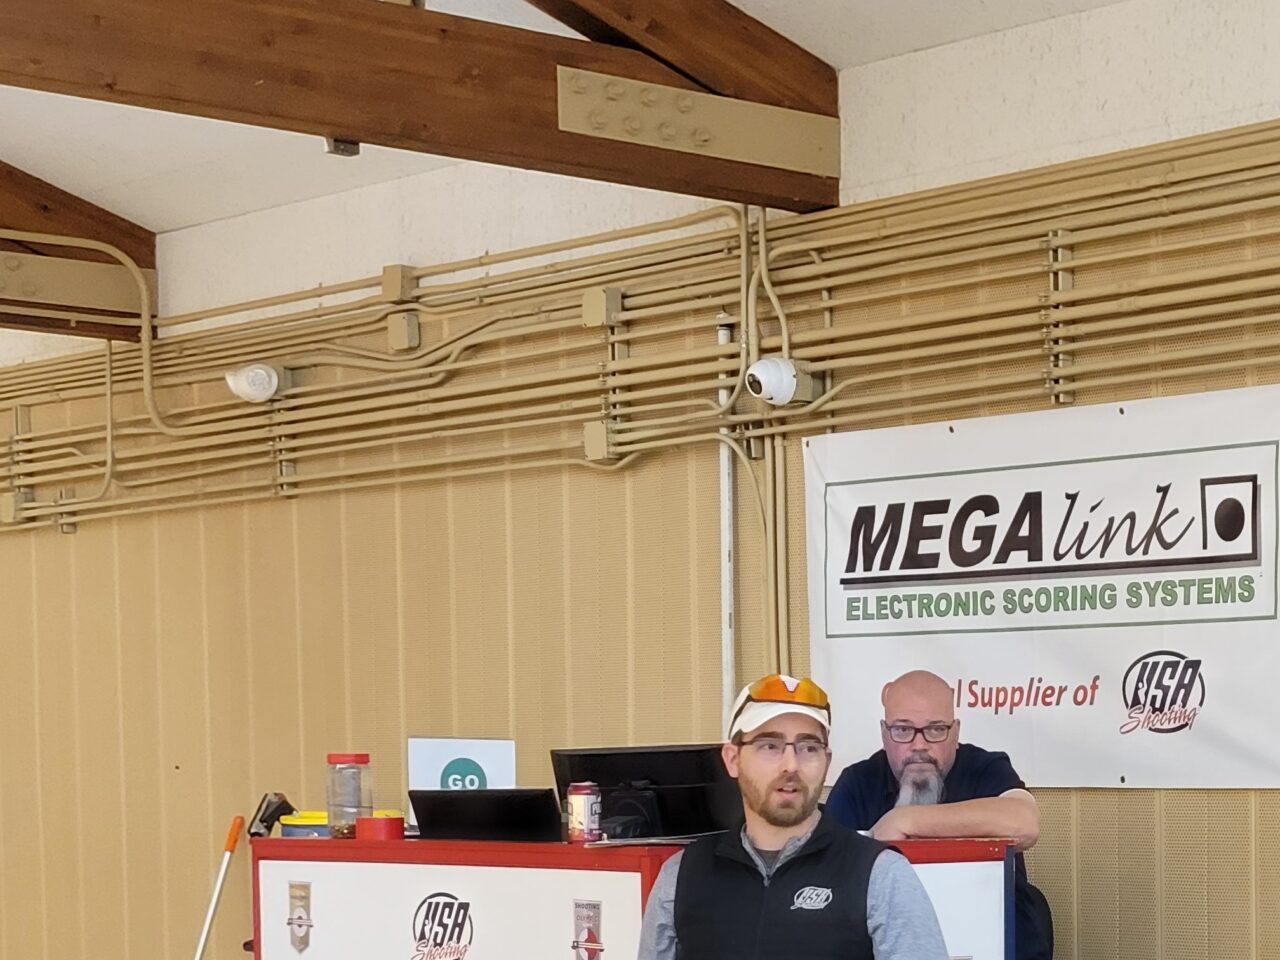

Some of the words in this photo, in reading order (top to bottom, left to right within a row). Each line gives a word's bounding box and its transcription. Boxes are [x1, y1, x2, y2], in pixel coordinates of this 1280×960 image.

[846, 589, 995, 621] ELECTRONIC
[1003, 583, 1117, 614] SCORING
[1126, 575, 1256, 607] SYSTEMS
[968, 677, 1067, 715] Supplier
[1073, 675, 1100, 706] of
[1129, 659, 1202, 714] USA
[1119, 704, 1198, 734] Shooting
[448, 774, 480, 790] GO
[418, 902, 470, 947] USA
